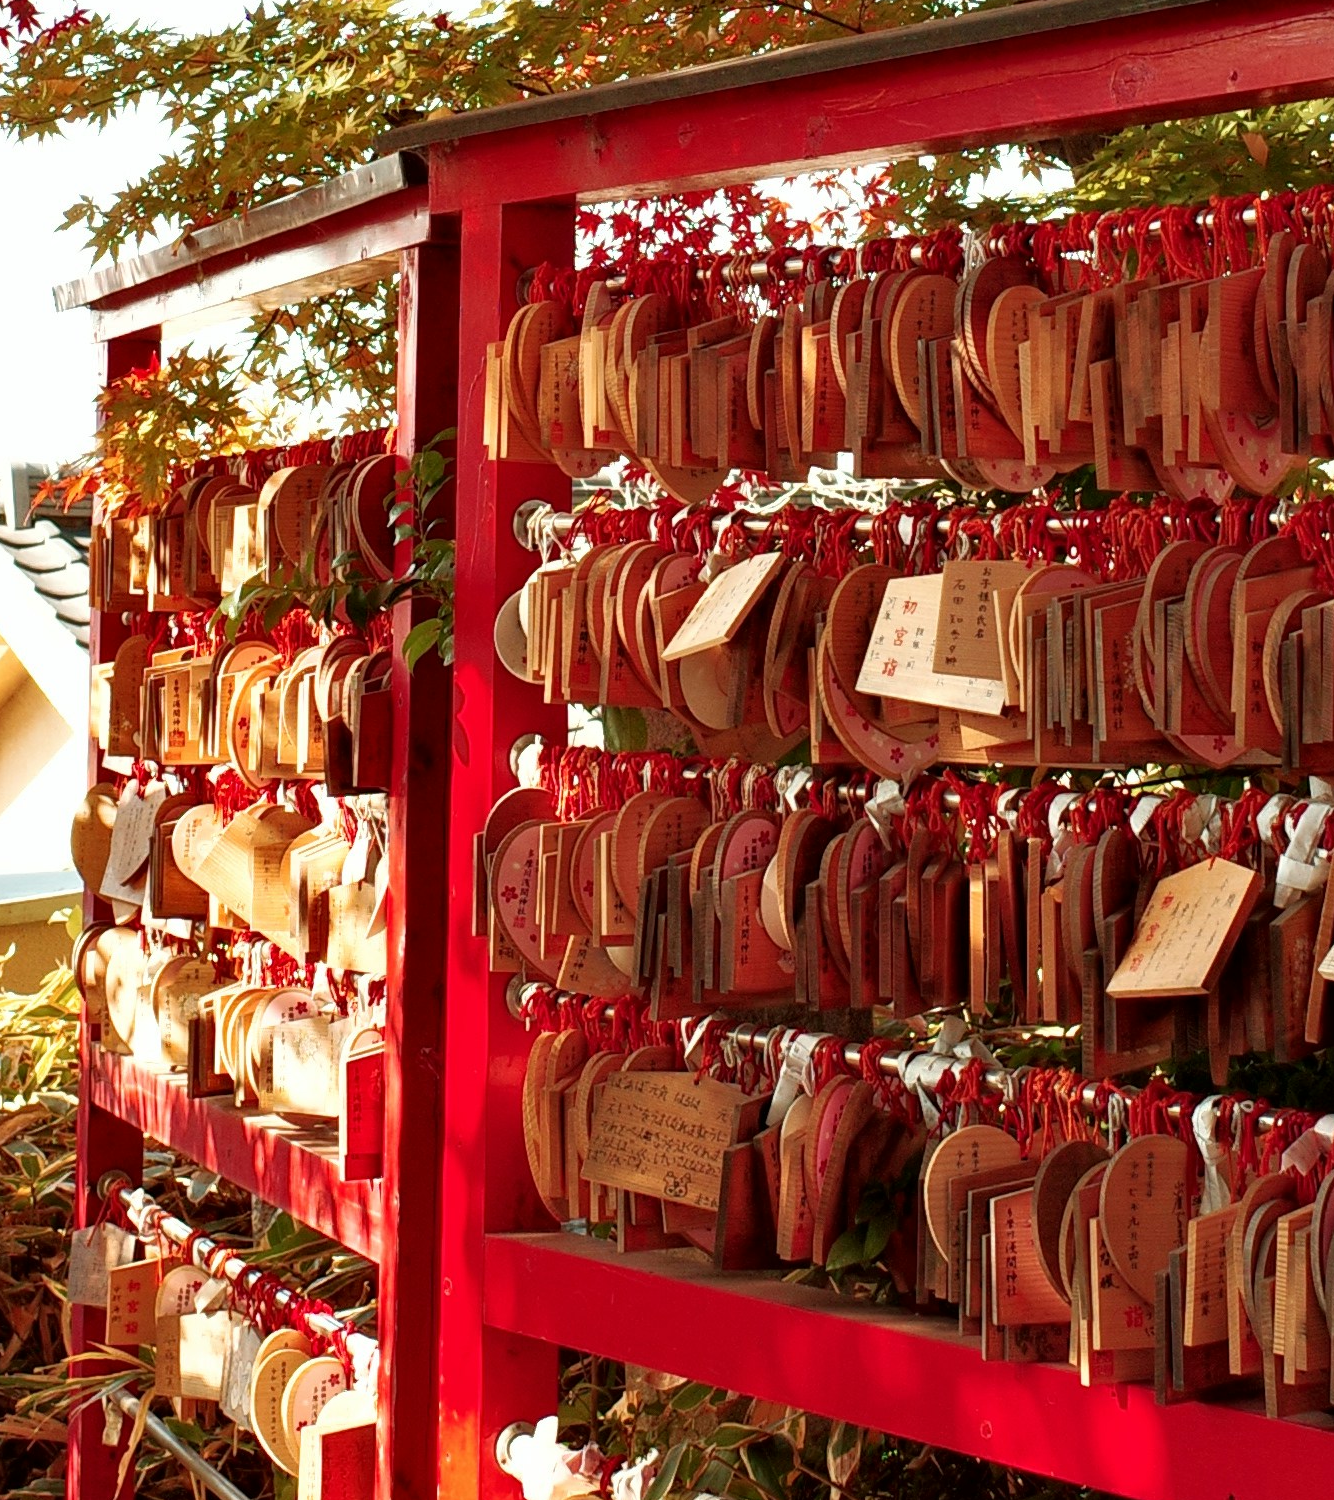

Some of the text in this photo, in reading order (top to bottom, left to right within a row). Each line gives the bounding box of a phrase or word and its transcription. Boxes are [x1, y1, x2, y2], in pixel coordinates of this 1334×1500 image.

[1004, 1207, 1018, 1298] 多摩川浅間神社
